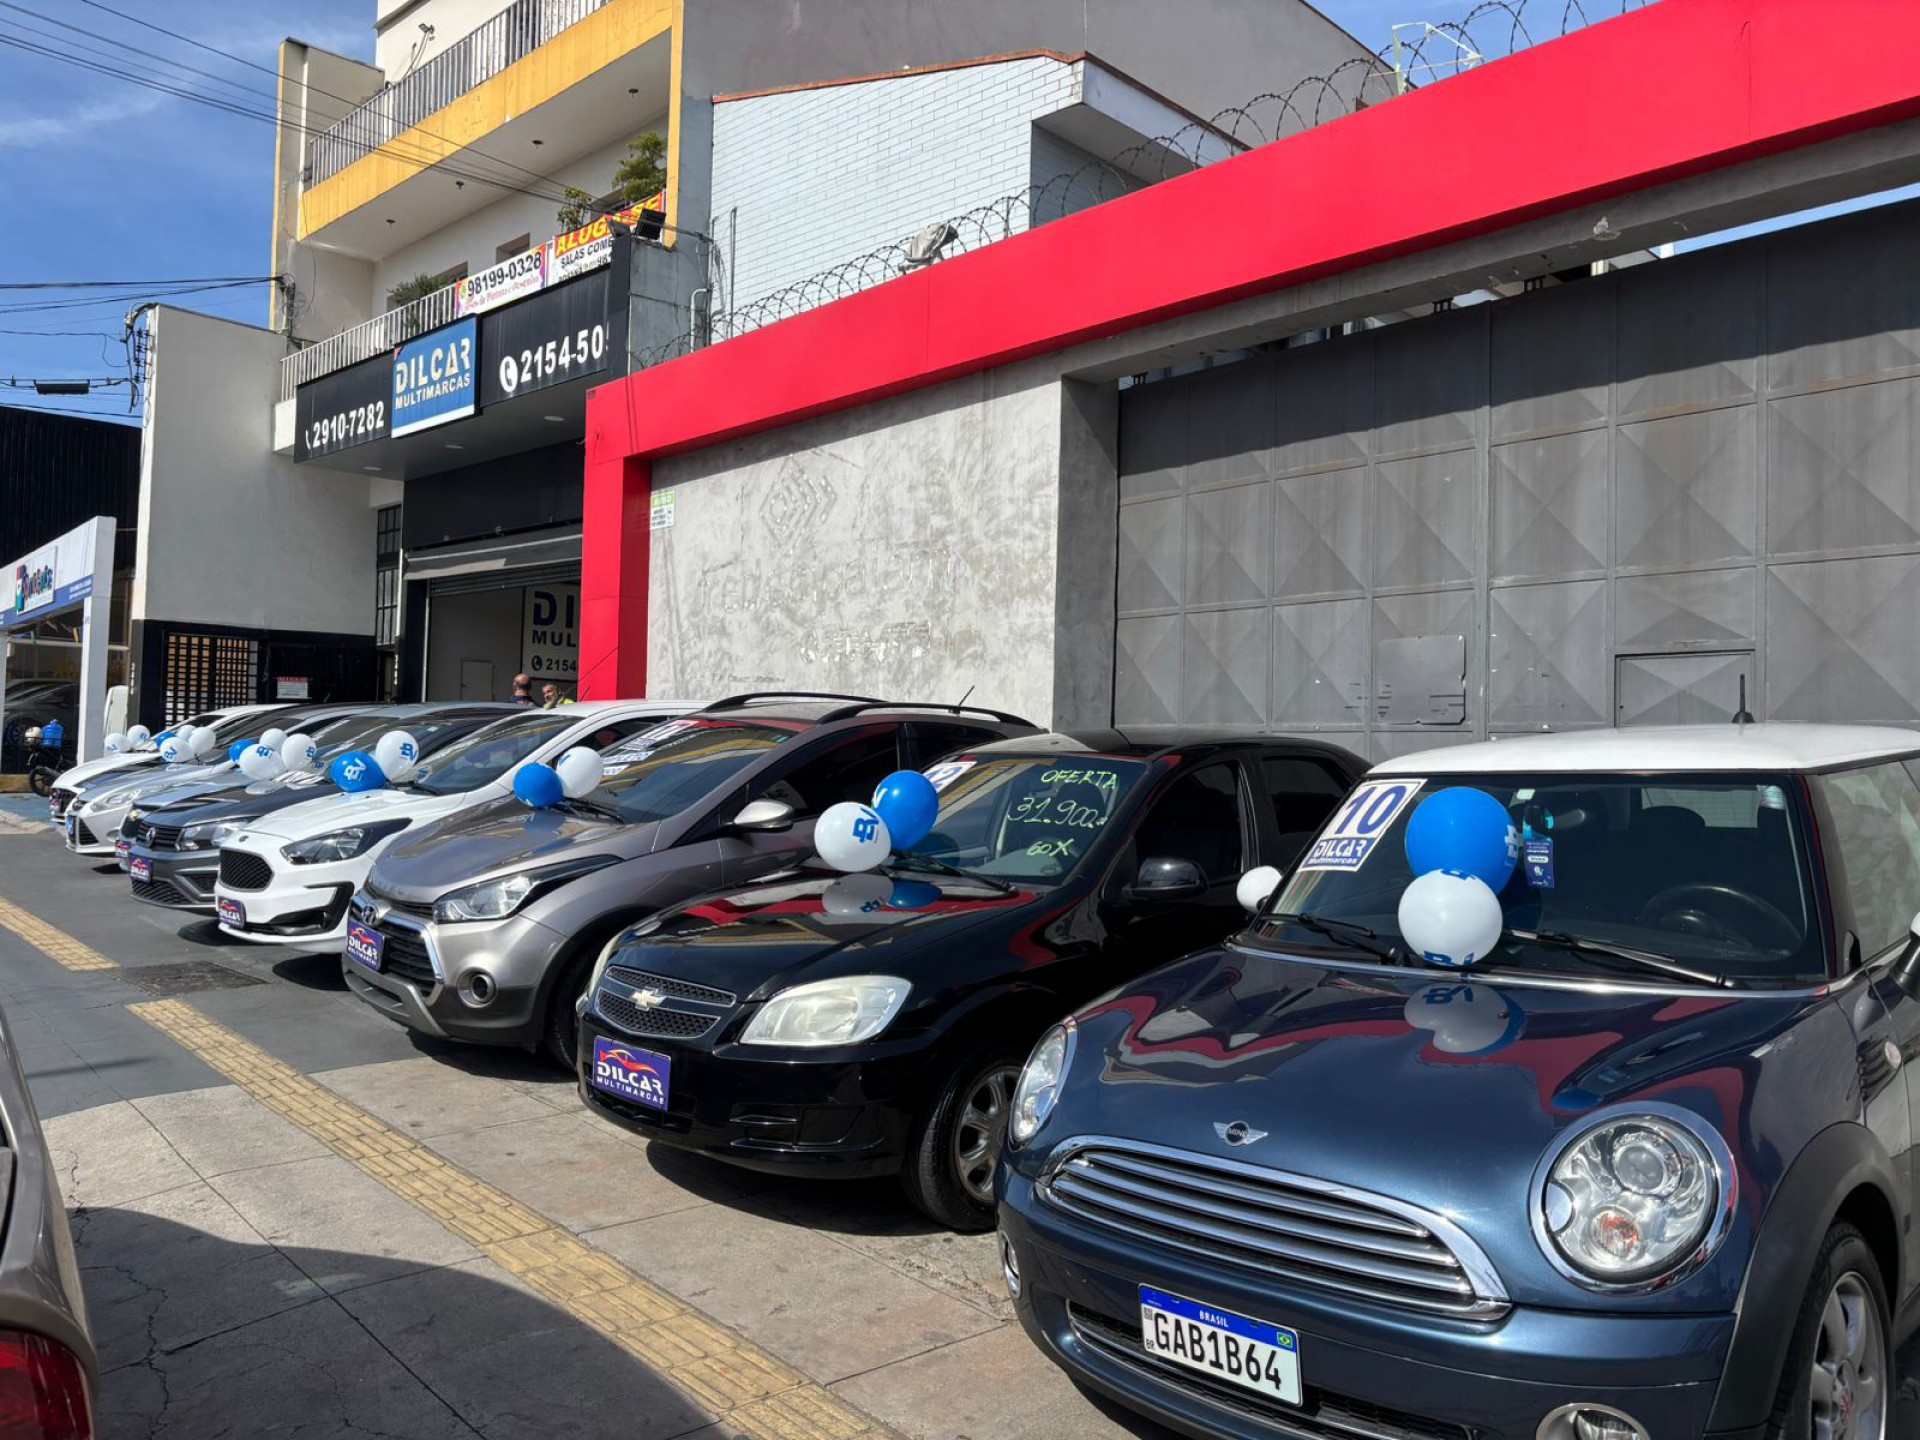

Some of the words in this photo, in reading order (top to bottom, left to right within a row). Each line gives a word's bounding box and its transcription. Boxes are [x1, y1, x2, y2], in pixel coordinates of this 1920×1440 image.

[468, 252, 541, 297] 98199-0328
[560, 247, 585, 268] SALAS
[396, 337, 471, 395] DILCAR
[520, 322, 609, 383] 2154-50
[395, 372, 471, 410] MULTIMARCAS
[312, 400, 385, 448] 2910-7282
[1041, 769, 1117, 789] OFERTA
[1334, 785, 1407, 835] 10
[1313, 839, 1367, 858] DILCAR
[348, 935, 379, 961] DILCAR
[596, 1076, 664, 1105] MULTIMARCAS
[597, 1061, 664, 1095] DILCAR
[1199, 1310, 1229, 1328] BRASIL
[1154, 1312, 1282, 1390] GAB1B64
